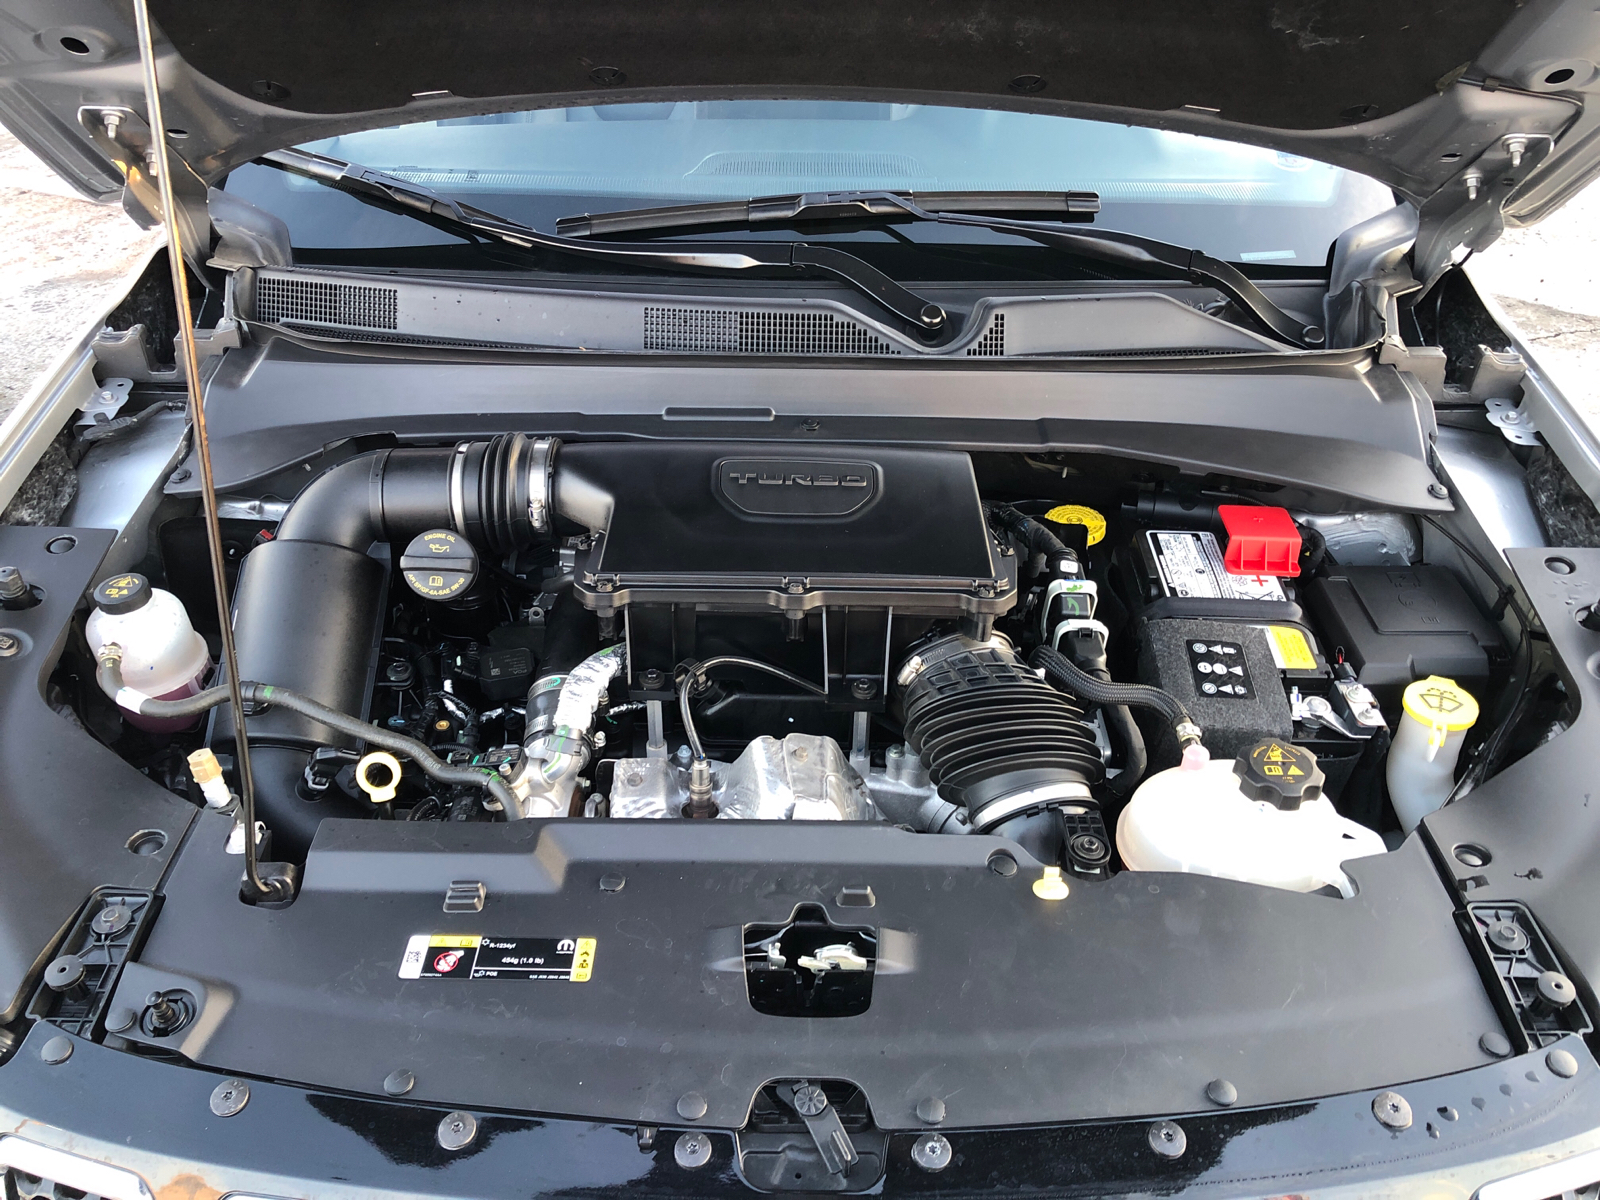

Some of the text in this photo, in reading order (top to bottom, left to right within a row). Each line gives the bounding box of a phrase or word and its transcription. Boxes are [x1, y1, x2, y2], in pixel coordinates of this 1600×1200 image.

[729, 472, 867, 487] TURBO
[424, 533, 455, 543] ENGINE OIL
[501, 956, 519, 965] 454g
